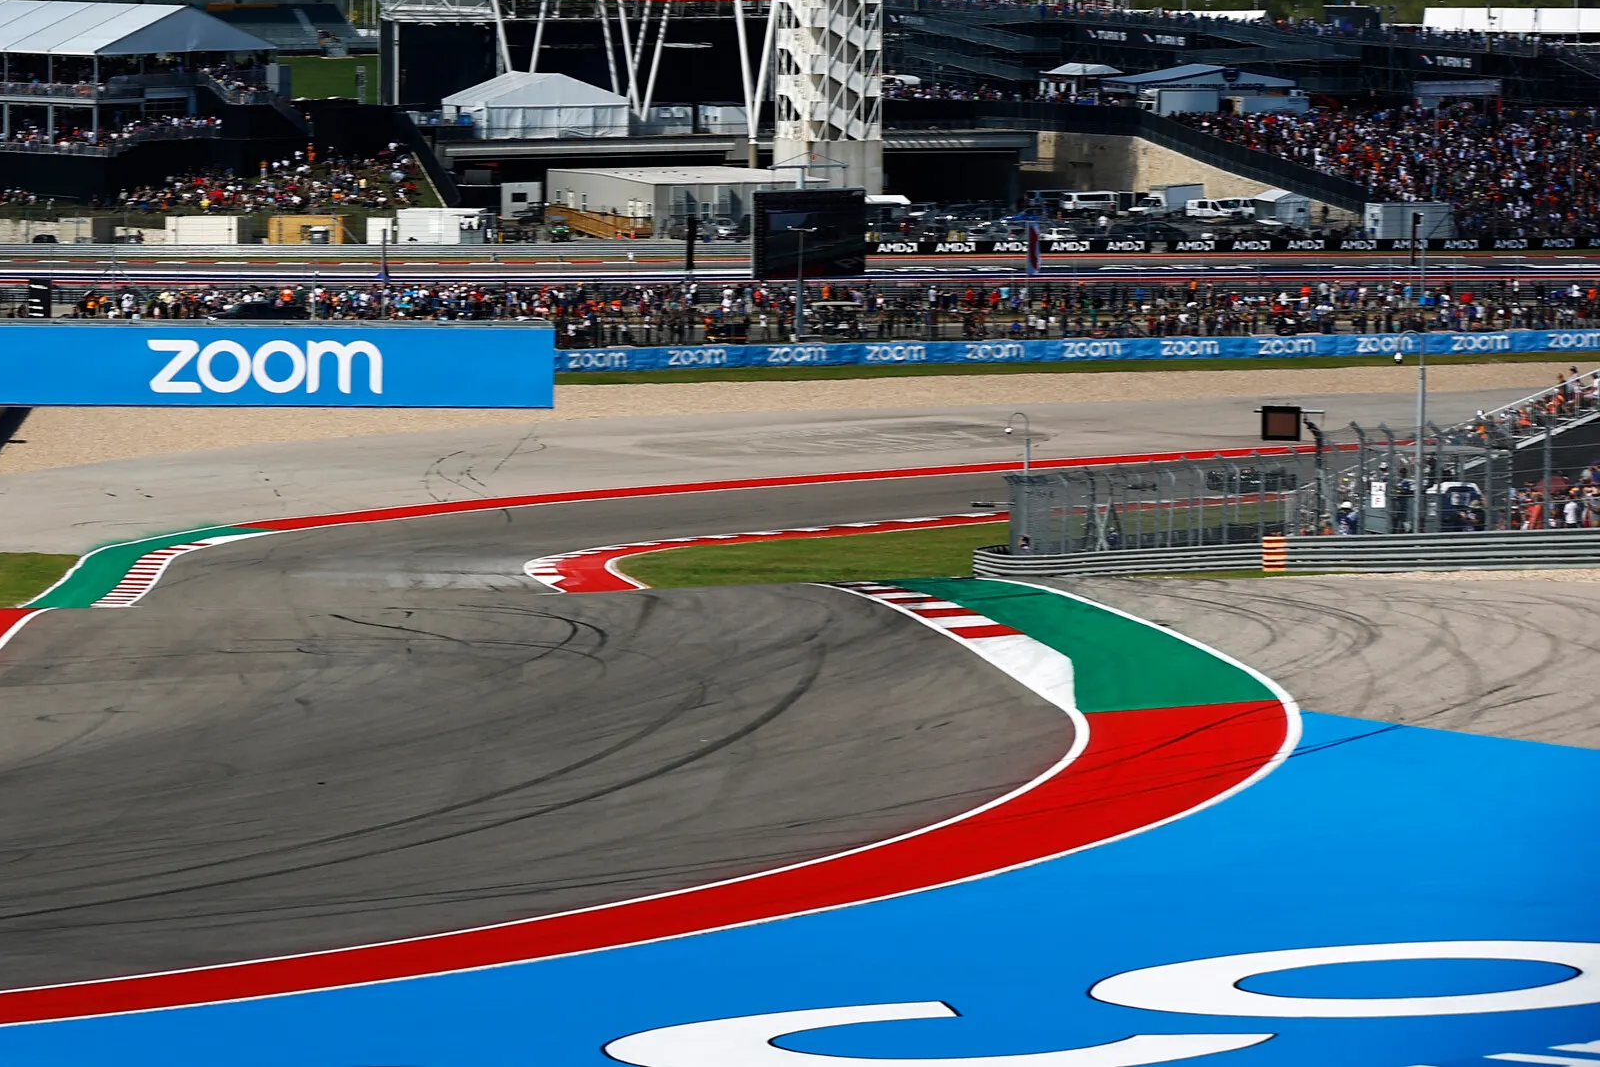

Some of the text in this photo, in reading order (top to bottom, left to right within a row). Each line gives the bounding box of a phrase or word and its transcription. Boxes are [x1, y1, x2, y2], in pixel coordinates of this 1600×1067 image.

[877, 243, 907, 253] AMD
[935, 242, 965, 252] AMD
[993, 242, 1022, 252] AMD
[1051, 241, 1080, 251] AMD
[1106, 241, 1136, 251] AMD
[1176, 241, 1205, 251] AMD
[1232, 240, 1261, 251] AMD
[1287, 240, 1316, 250] AMD
[1340, 240, 1369, 250] AMD
[1443, 239, 1468, 249] AMD
[1063, 340, 1122, 358] zoom
[1160, 339, 1220, 356] zoom
[1258, 337, 1317, 355] zoom
[1354, 334, 1413, 353] zoom
[1451, 333, 1510, 351] zoom
[568, 350, 628, 369] zoom
[668, 347, 727, 365] zoom
[766, 345, 827, 363] zoom
[865, 343, 926, 361] zoom
[965, 342, 1025, 360] zoom
[147, 338, 383, 394] zoom
